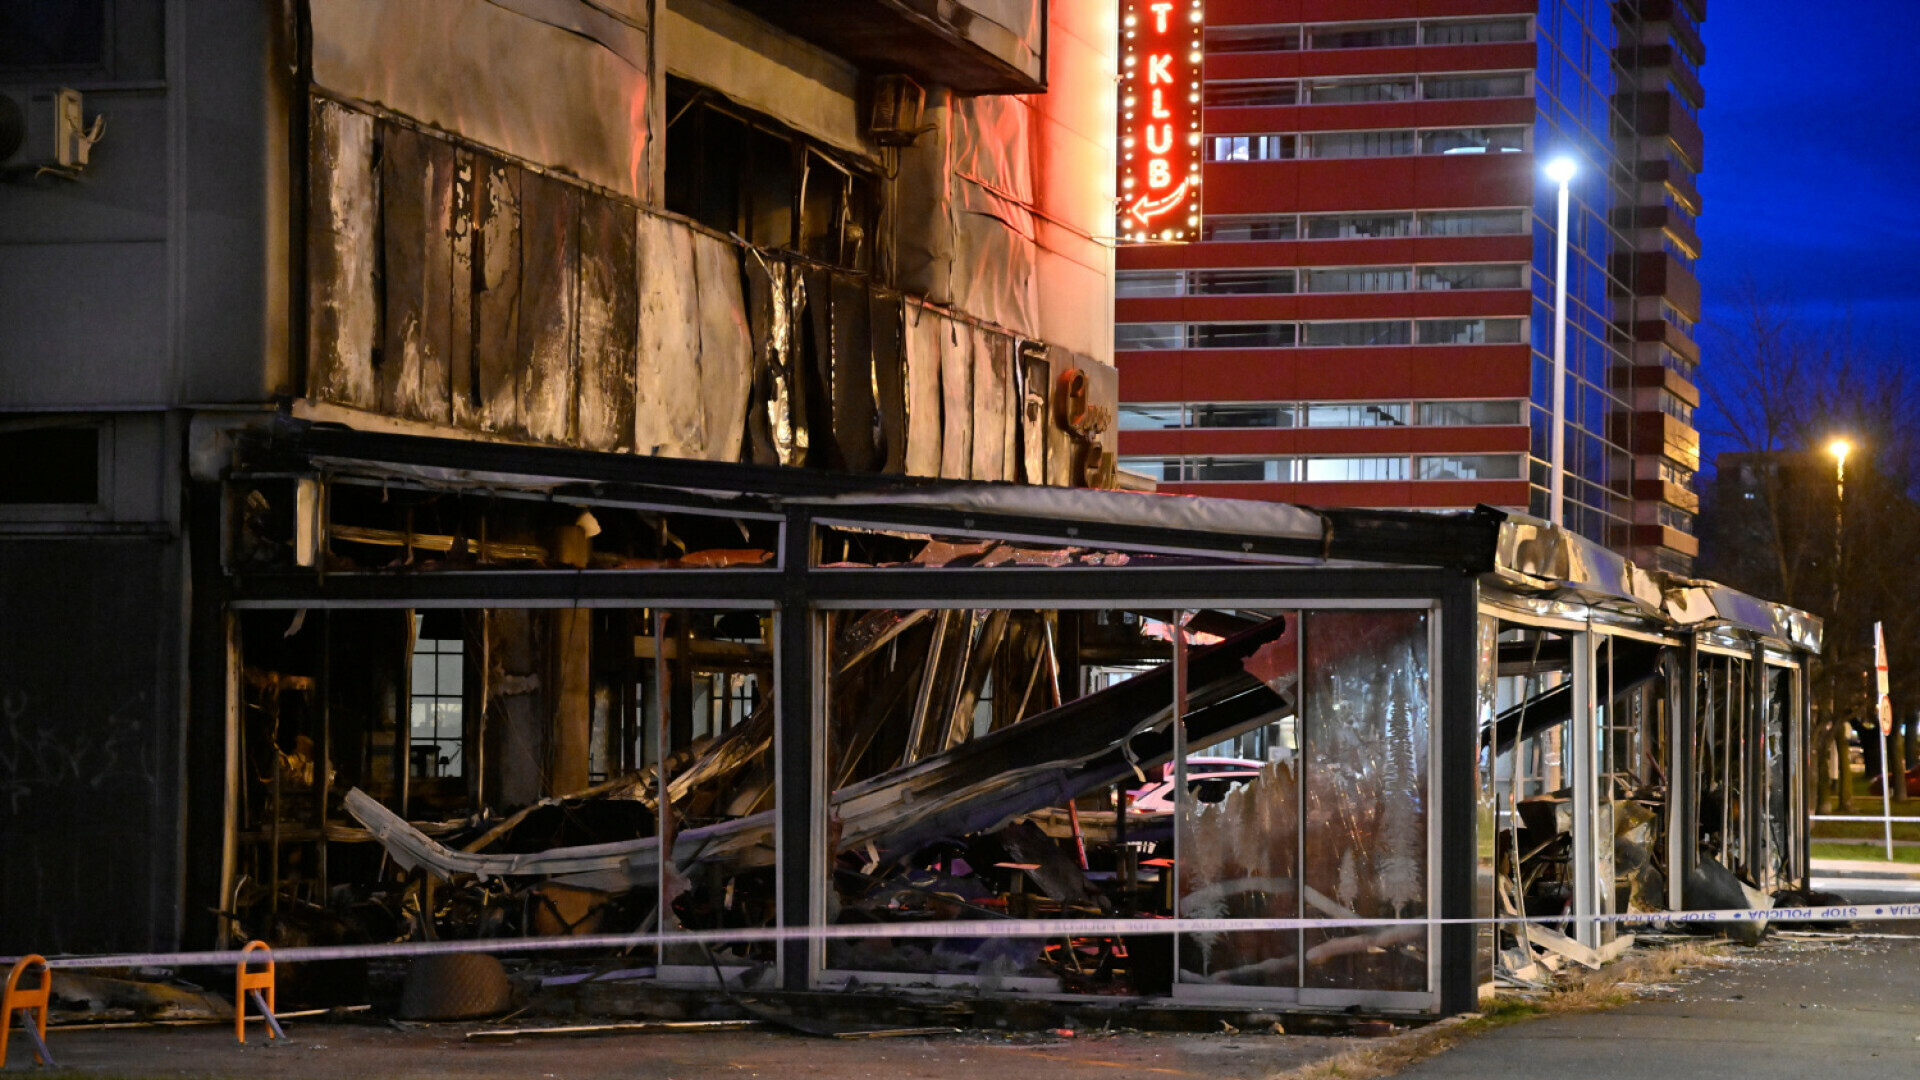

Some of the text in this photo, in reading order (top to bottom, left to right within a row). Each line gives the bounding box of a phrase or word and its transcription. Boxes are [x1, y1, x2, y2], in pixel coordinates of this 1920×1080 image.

[1146, 54, 1174, 188] KLUB
[1680, 912, 1717, 921] STOP
[1748, 909, 1812, 920] POLICIJA
[1821, 907, 1858, 918] STOP
